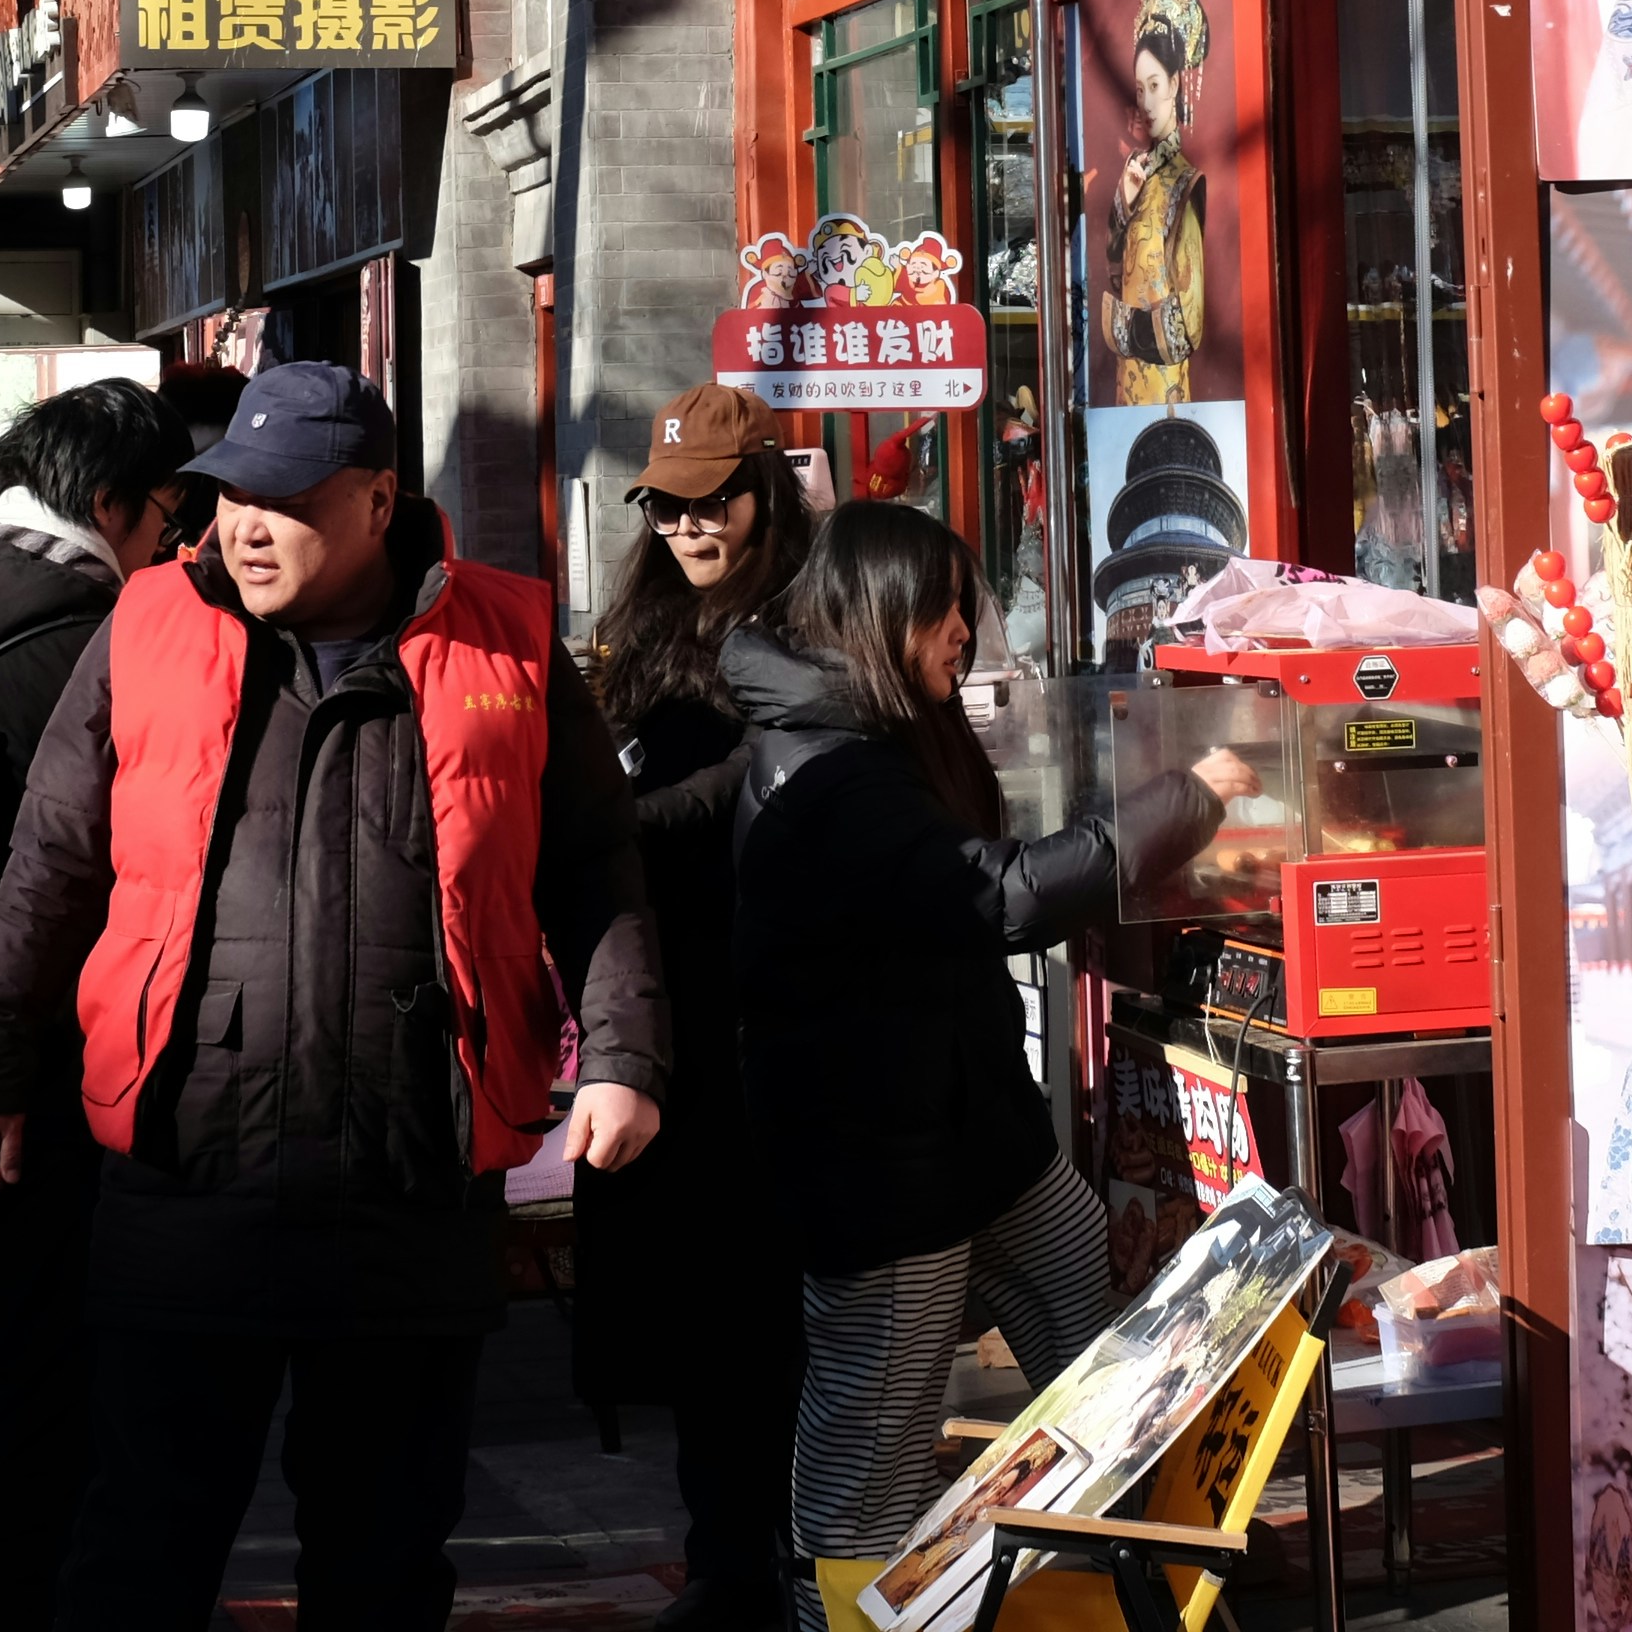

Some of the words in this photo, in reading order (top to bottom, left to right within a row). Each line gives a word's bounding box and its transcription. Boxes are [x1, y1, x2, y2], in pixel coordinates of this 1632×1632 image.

[745, 319, 954, 366] 指谁谁发财
[771, 380, 923, 399] 发财的风吹到了这里
[944, 379, 960, 397] 北
[663, 418, 682, 444] R
[1112, 1045, 1250, 1167] 美味烤肉肠
